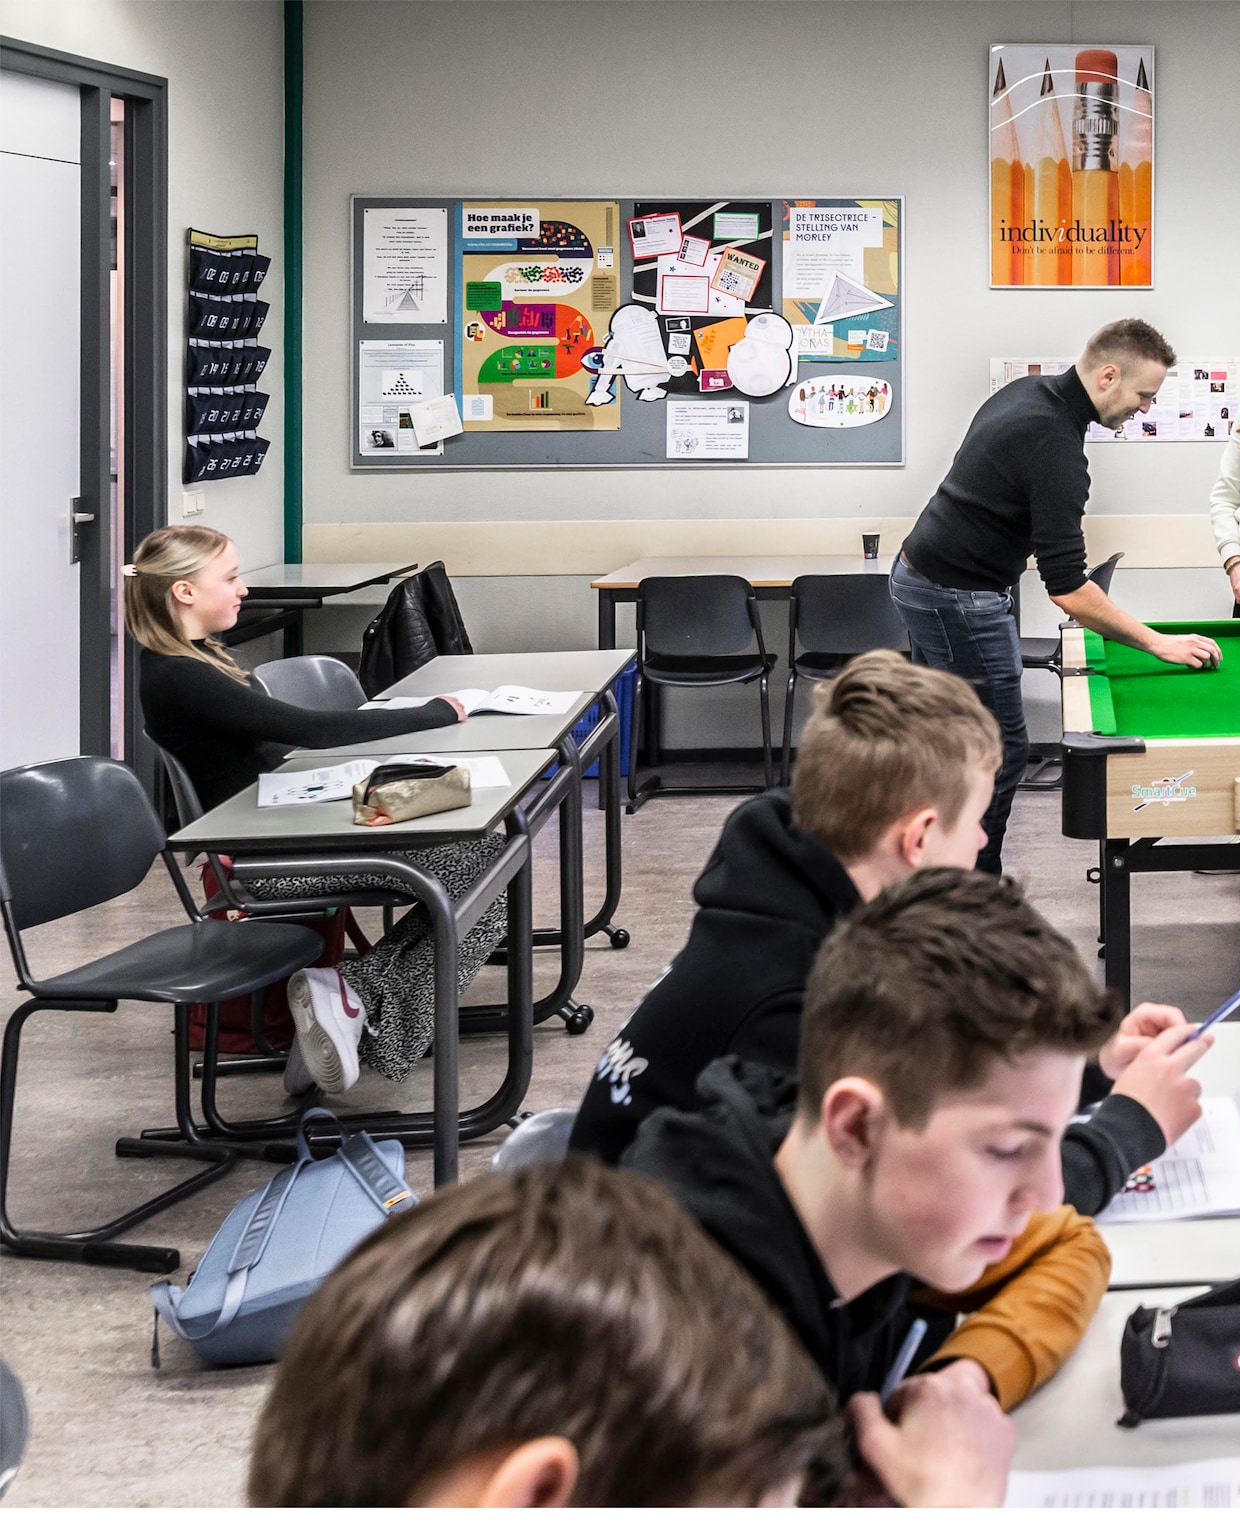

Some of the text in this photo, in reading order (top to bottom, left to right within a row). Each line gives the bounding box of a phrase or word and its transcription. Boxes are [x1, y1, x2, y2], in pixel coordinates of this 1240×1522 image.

[467, 213, 533, 223] Hoe maak je
[796, 213, 806, 221] DE
[490, 223, 534, 233] grafiek?
[795, 223, 859, 231] STELLING VAN
[795, 233, 832, 241] MORLEY
[1000, 219, 1148, 250] individuality
[1011, 245, 1135, 254] Don't be afraid to be different.
[726, 252, 760, 272] WANTED
[206, 268, 230, 283] 02 03
[206, 314, 218, 328] 08
[209, 362, 220, 375] 14
[255, 360, 266, 372] 18
[207, 409, 220, 422] 20
[220, 411, 231, 423] 21
[206, 458, 219, 471] 26
[220, 458, 232, 470] 27
[1131, 784, 1197, 799] SmartCue
